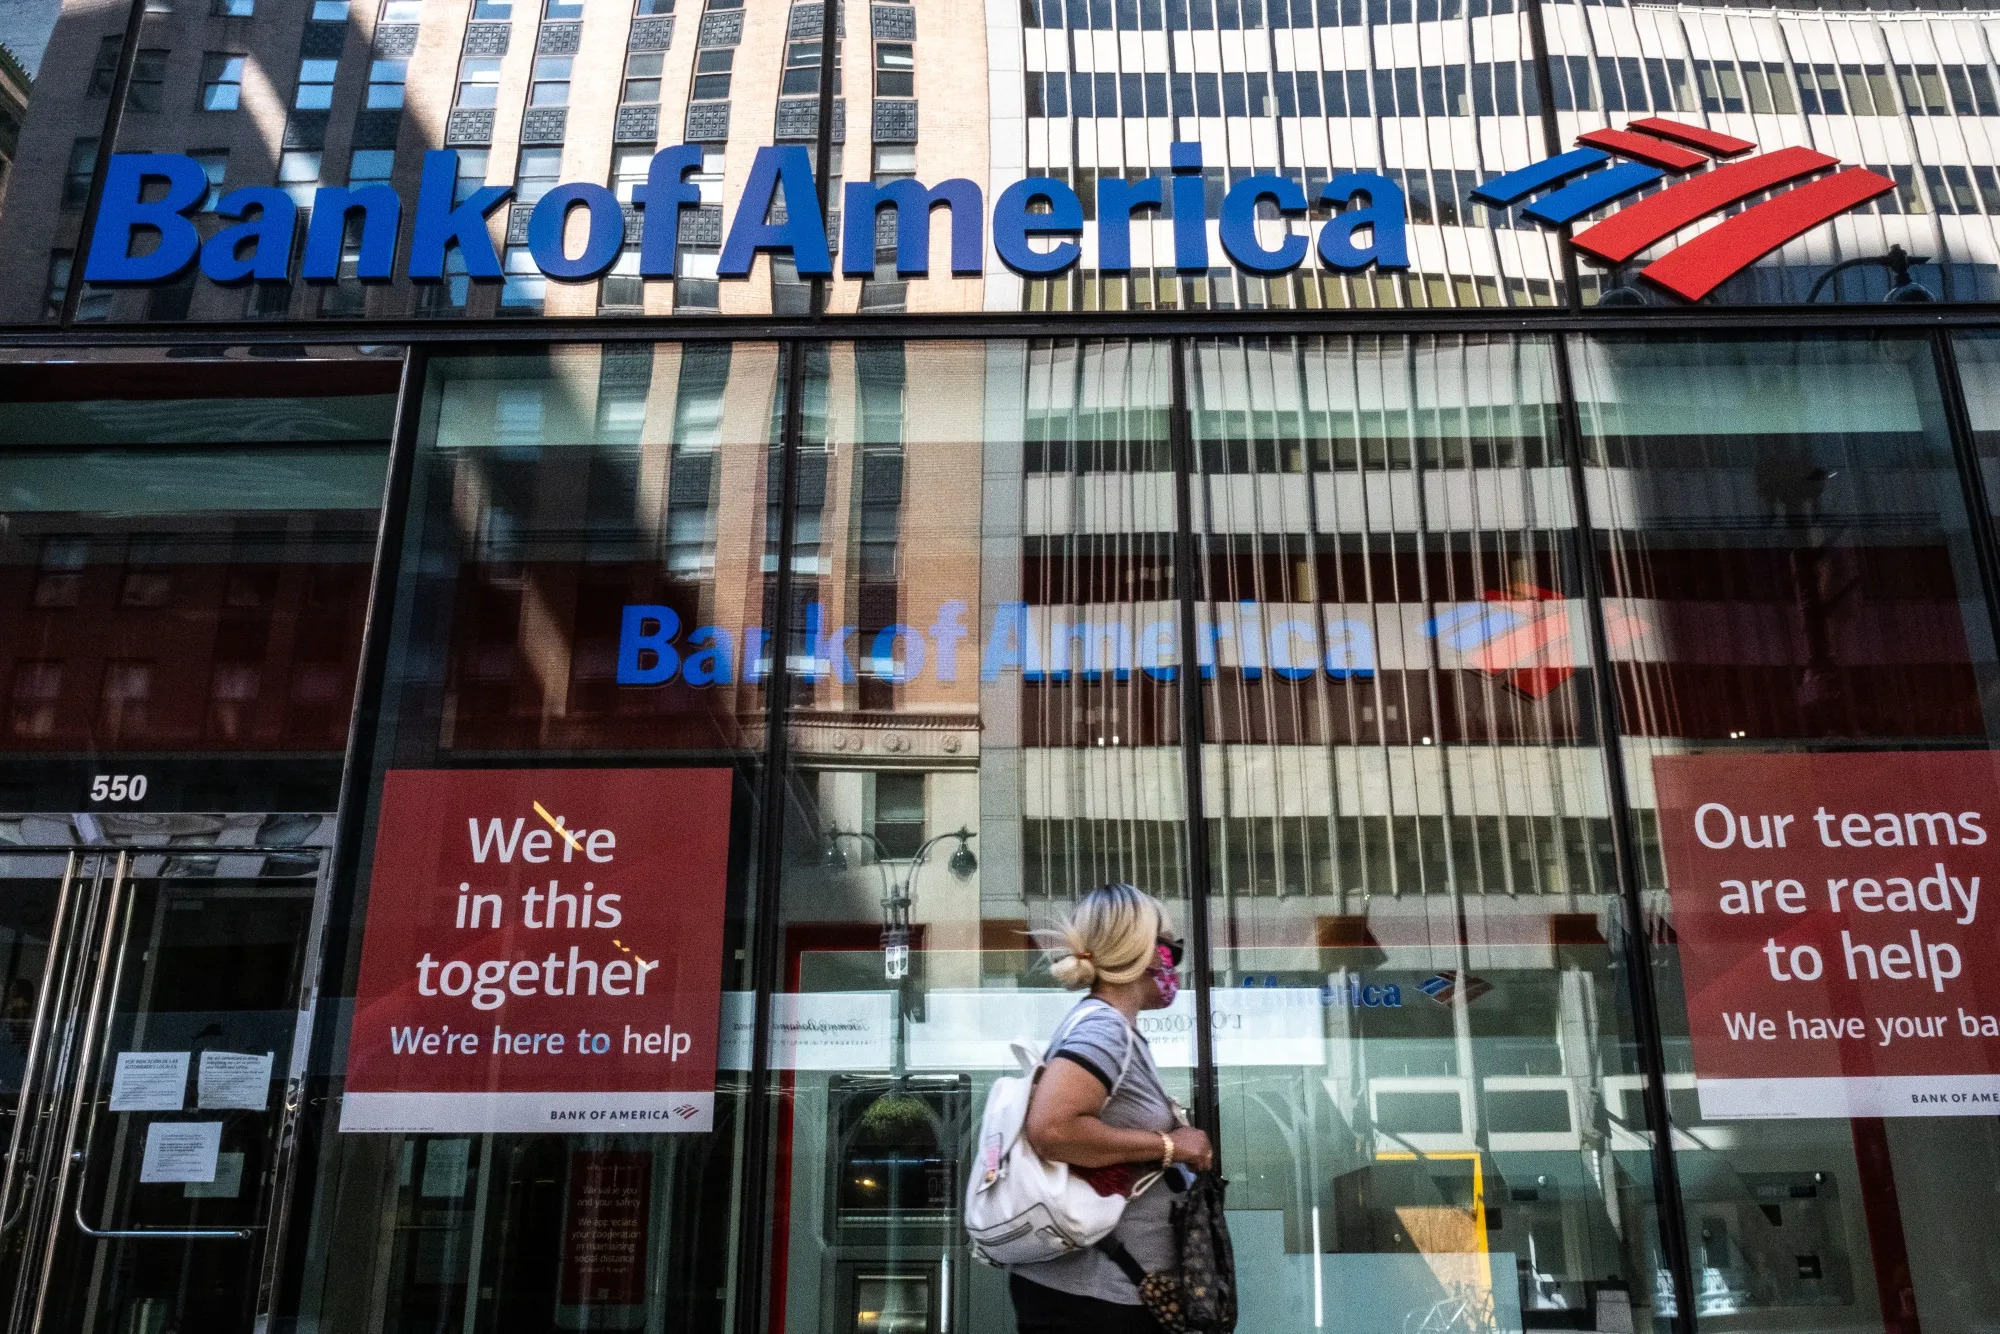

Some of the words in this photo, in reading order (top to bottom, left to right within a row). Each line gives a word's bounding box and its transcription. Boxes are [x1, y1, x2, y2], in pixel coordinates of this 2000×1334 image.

[84, 148, 516, 284] Bank
[527, 144, 704, 280] of
[716, 142, 1411, 278] America
[871, 600, 968, 684] of
[979, 599, 1378, 684] America
[90, 775, 148, 802] 550
[468, 814, 616, 864] We're
[1694, 802, 1795, 850] Our
[1813, 806, 1987, 848] teams
[455, 882, 502, 929] in
[521, 880, 622, 929] this
[1719, 879, 1807, 915] are
[1827, 862, 1980, 925] ready
[416, 946, 659, 1011] together
[1762, 938, 1823, 982] to
[1841, 929, 1962, 993] help
[391, 1026, 479, 1055] We're
[493, 1025, 565, 1055] here
[577, 1028, 611, 1055] to
[623, 1024, 692, 1062] help
[1722, 1012, 1777, 1041] We
[1787, 1010, 1865, 1040] have
[1875, 1016, 1948, 1047] your
[1957, 1007, 2000, 1038] ba
[550, 1110, 586, 1120] BANK
[589, 1110, 607, 1120] OF
[609, 1110, 670, 1120] AMERICA
[1911, 1094, 1948, 1104] BANK
[1951, 1093, 1968, 1103] OF
